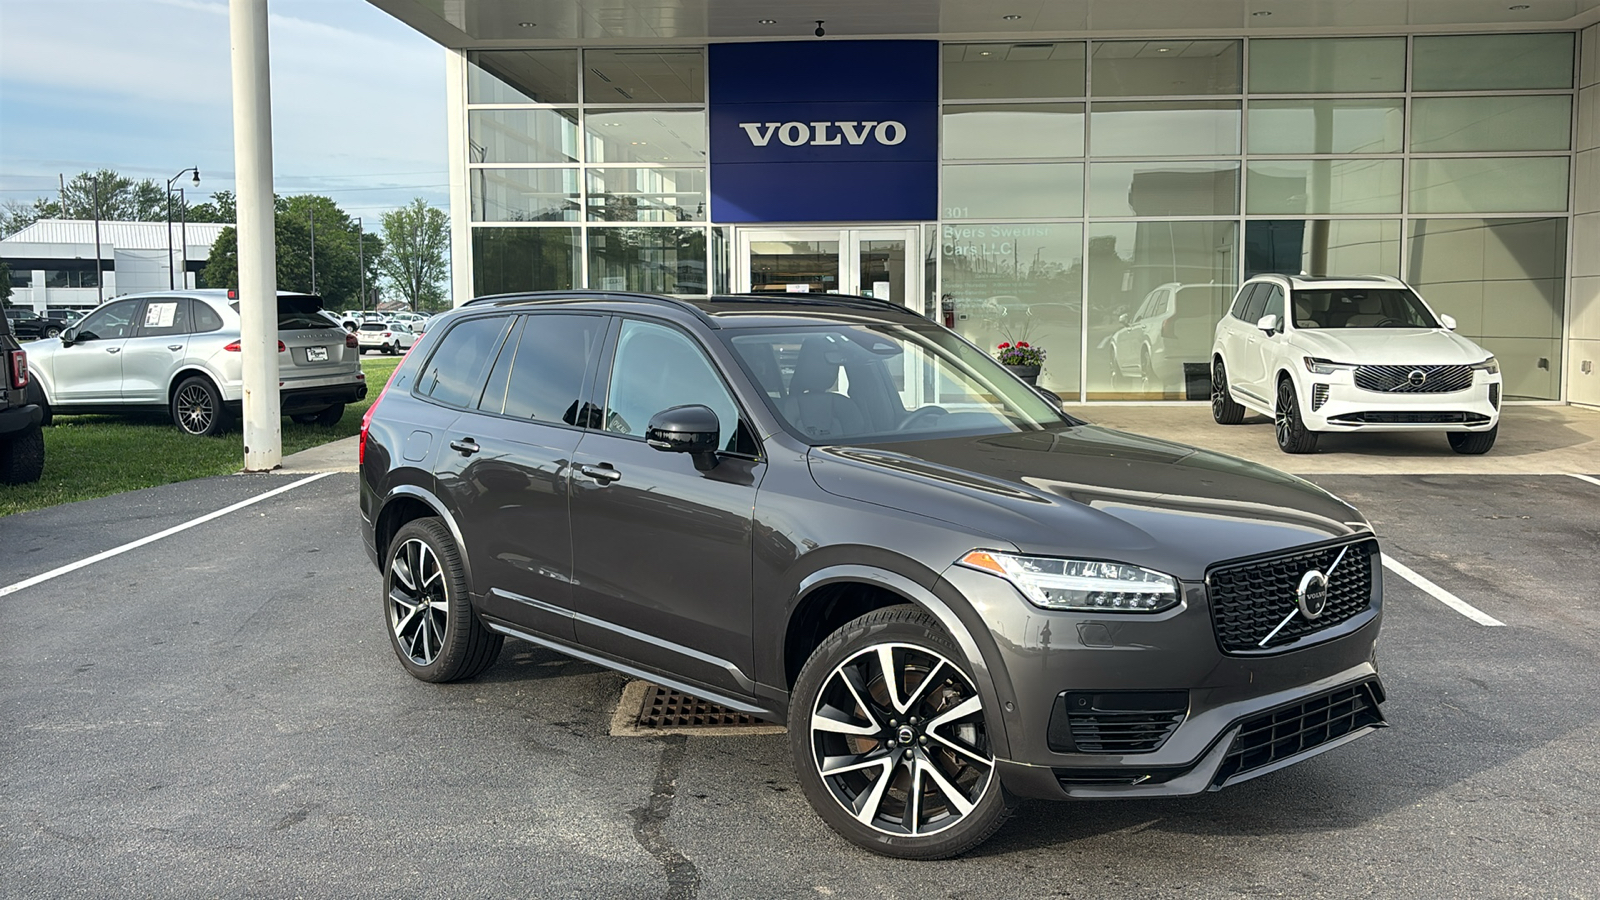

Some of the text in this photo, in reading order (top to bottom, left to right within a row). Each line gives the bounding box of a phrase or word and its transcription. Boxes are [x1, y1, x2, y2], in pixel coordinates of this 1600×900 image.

[739, 120, 907, 147] VOLVO
[944, 207, 969, 218] 301
[943, 226, 986, 241] Byers
[943, 242, 1012, 256] Cars LLC
